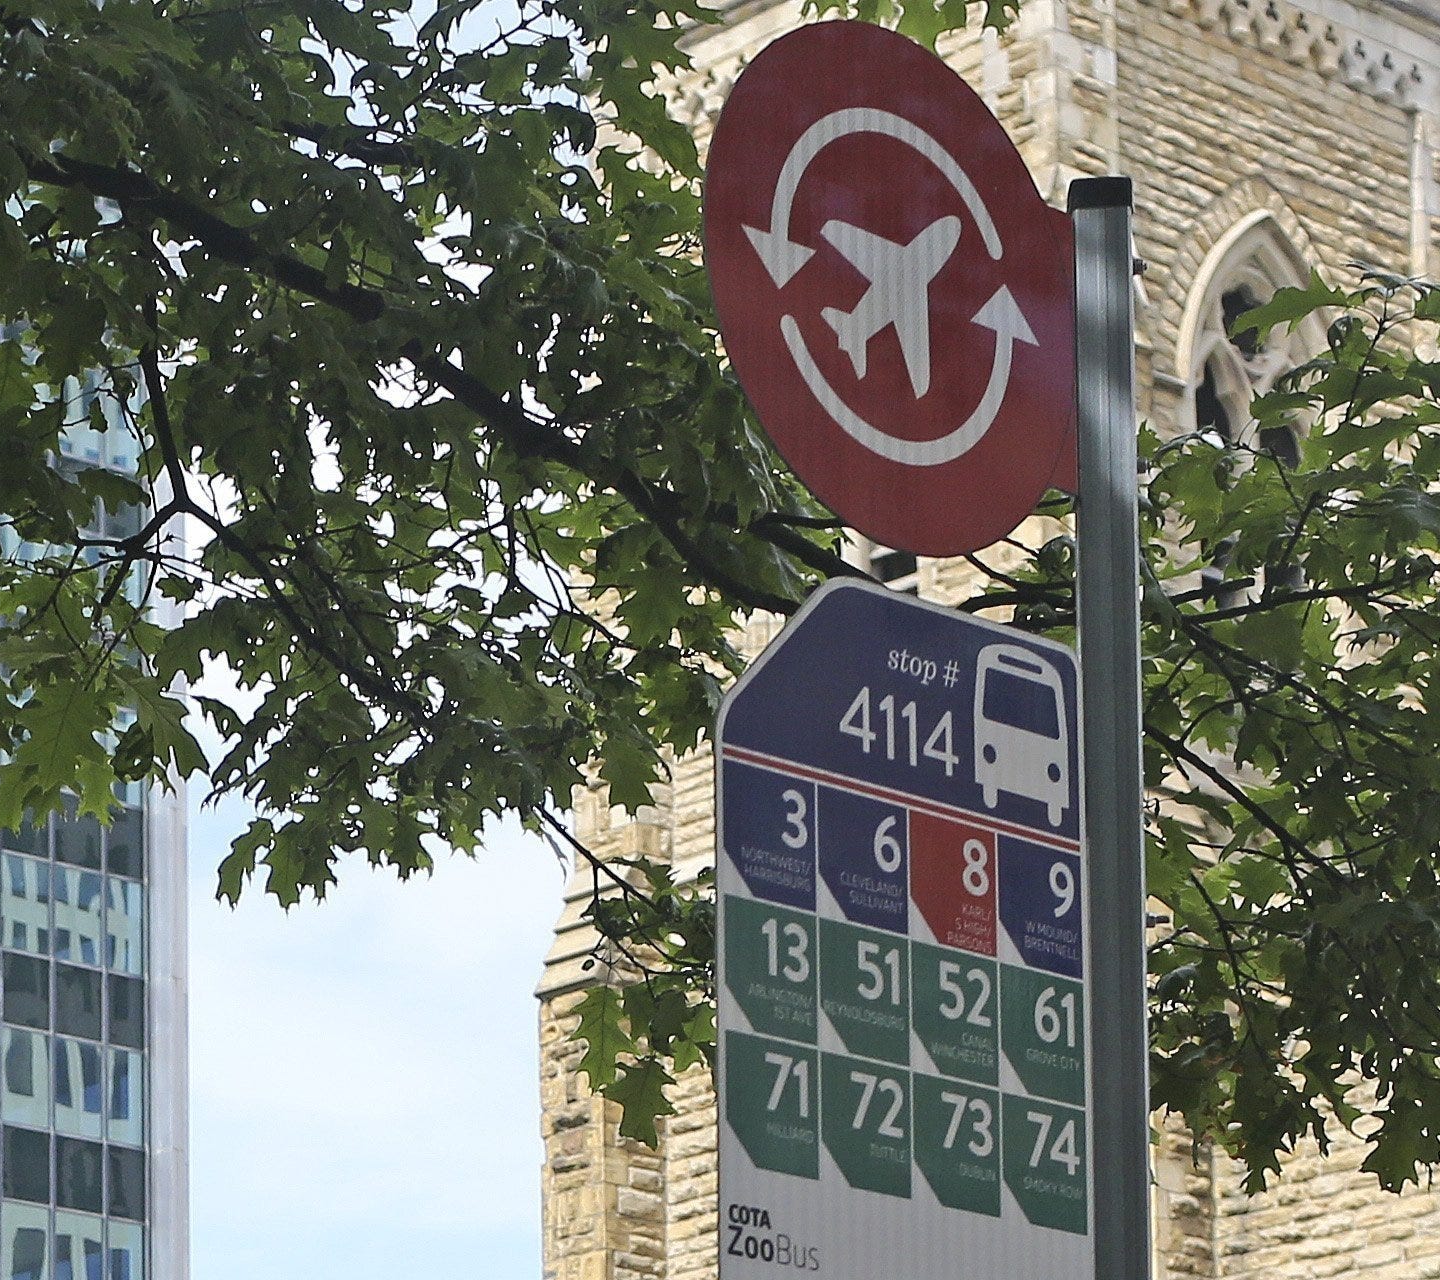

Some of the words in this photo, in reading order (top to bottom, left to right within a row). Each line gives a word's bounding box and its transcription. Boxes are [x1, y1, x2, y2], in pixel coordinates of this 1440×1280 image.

[888, 648, 937, 685] stop
[942, 660, 962, 688] #
[839, 686, 959, 777] 4114
[781, 789, 808, 849] 3
[873, 815, 902, 873] 6
[962, 839, 990, 897] 8
[1049, 861, 1075, 919] 9
[761, 917, 810, 983] 13
[857, 940, 901, 1006] 51
[938, 960, 993, 1028] 52
[1034, 986, 1076, 1048] 61
[764, 1051, 809, 1118] 71
[850, 1071, 905, 1139] 72
[940, 1091, 993, 1157] 73
[1026, 1111, 1081, 1176] 74
[728, 1203, 771, 1230] COTA
[727, 1226, 820, 1271] ZooBus
